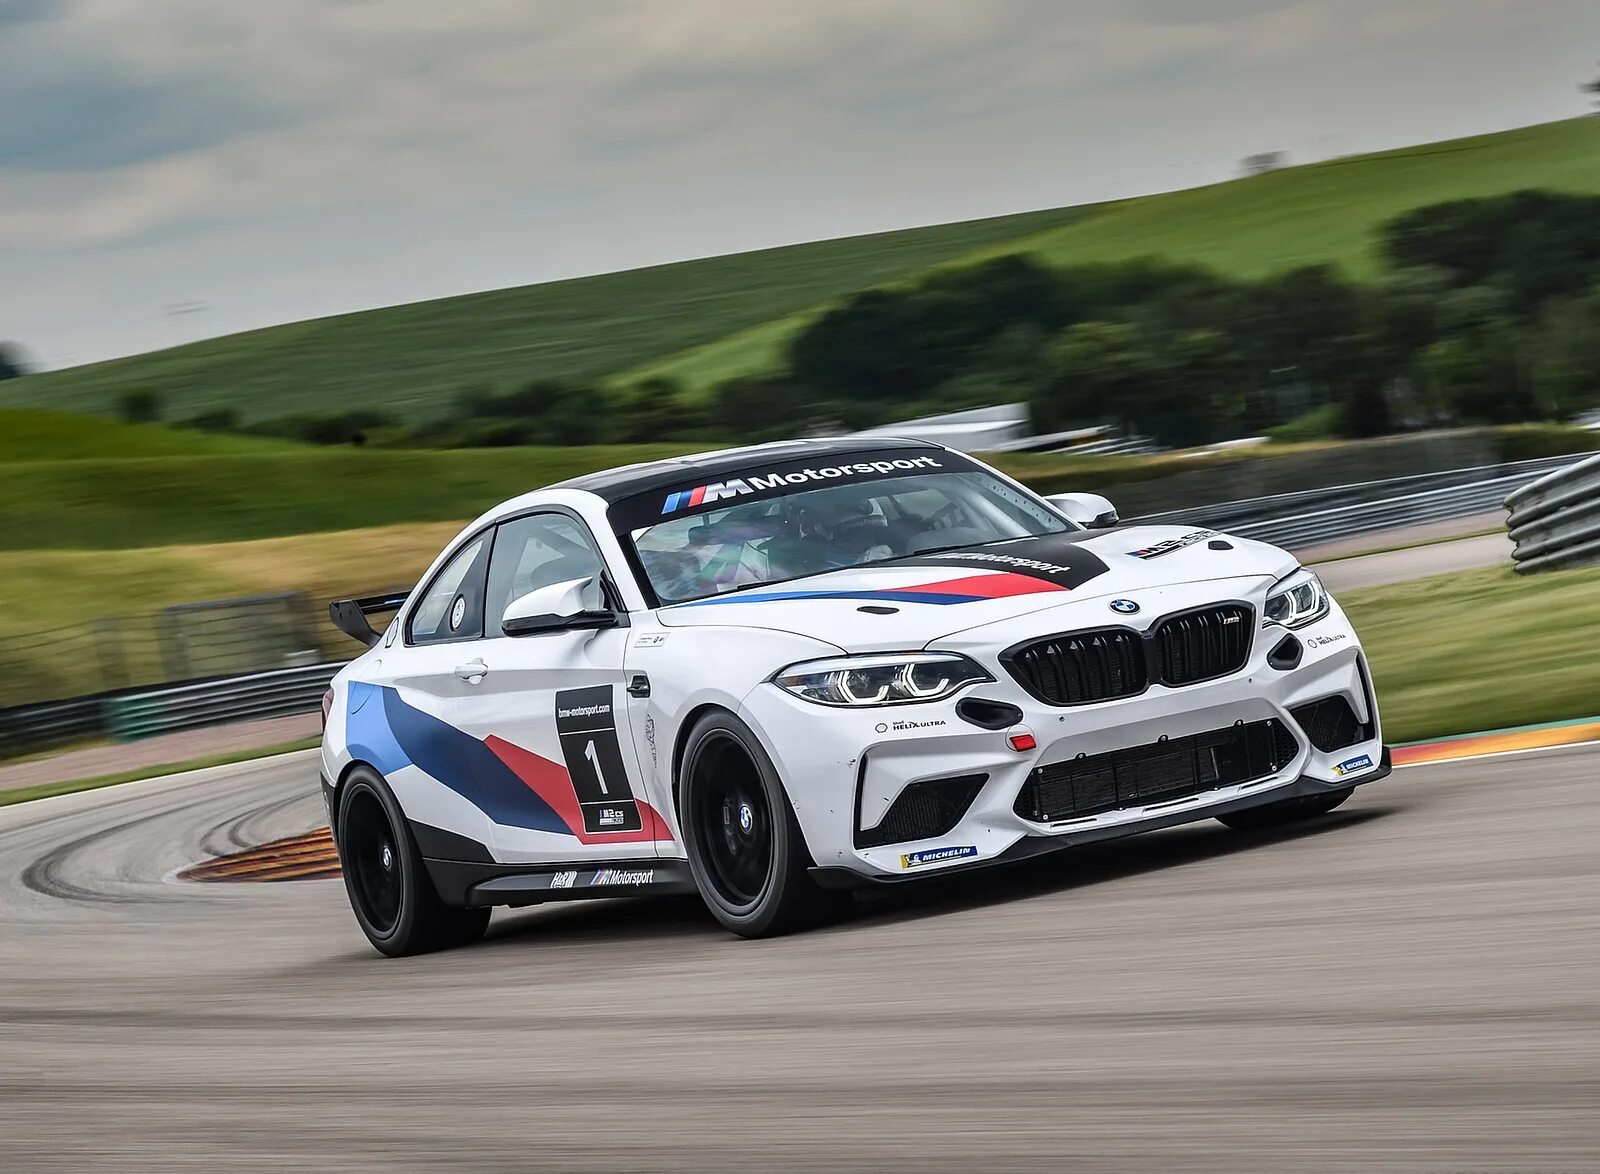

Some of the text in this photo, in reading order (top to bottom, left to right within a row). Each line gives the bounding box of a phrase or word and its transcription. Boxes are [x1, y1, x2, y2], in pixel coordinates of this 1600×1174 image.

[750, 456, 942, 492] Motorsport
[976, 553, 1071, 574] Motorsport
[558, 704, 611, 718] bmw-motorsport.com
[893, 720, 947, 731] HELIX ULTRA
[584, 740, 609, 795] 1
[922, 847, 971, 862] MICHELIN
[610, 869, 654, 887] Motorsport
